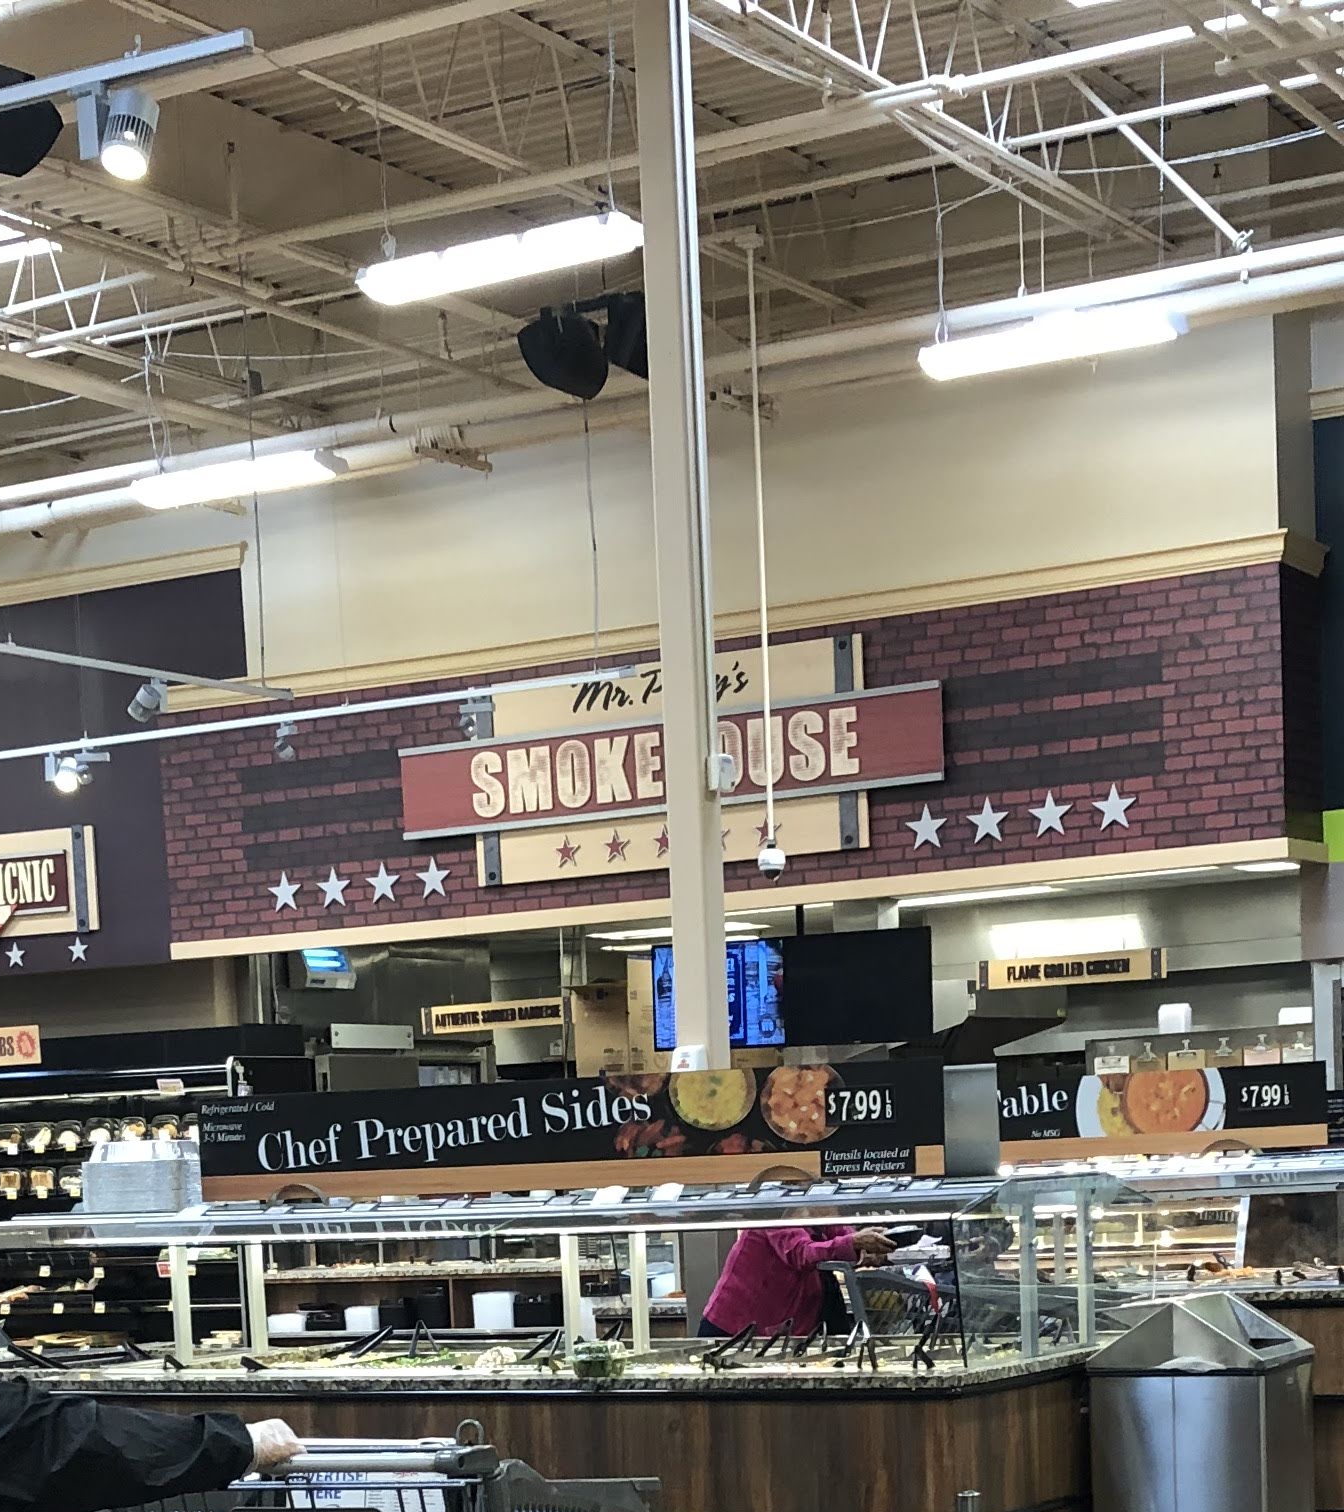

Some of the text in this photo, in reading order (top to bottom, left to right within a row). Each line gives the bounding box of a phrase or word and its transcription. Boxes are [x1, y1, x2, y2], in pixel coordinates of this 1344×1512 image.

[571, 660, 749, 714] Mr. Py's
[470, 703, 860, 820] SMOKEOUSE
[828, 1089, 882, 1121] $7.99
[997, 1082, 1069, 1118] able
[1240, 1084, 1282, 1108] $7.99
[201, 1102, 249, 1116] Refrigerated
[256, 1101, 275, 1112] Cold
[202, 1122, 243, 1132] Microwave
[216, 1132, 246, 1142] Minutes
[257, 1085, 653, 1172] Chef Prepared Sides
[824, 1147, 910, 1161] Utensils located at
[824, 1160, 906, 1175] Express Registers
